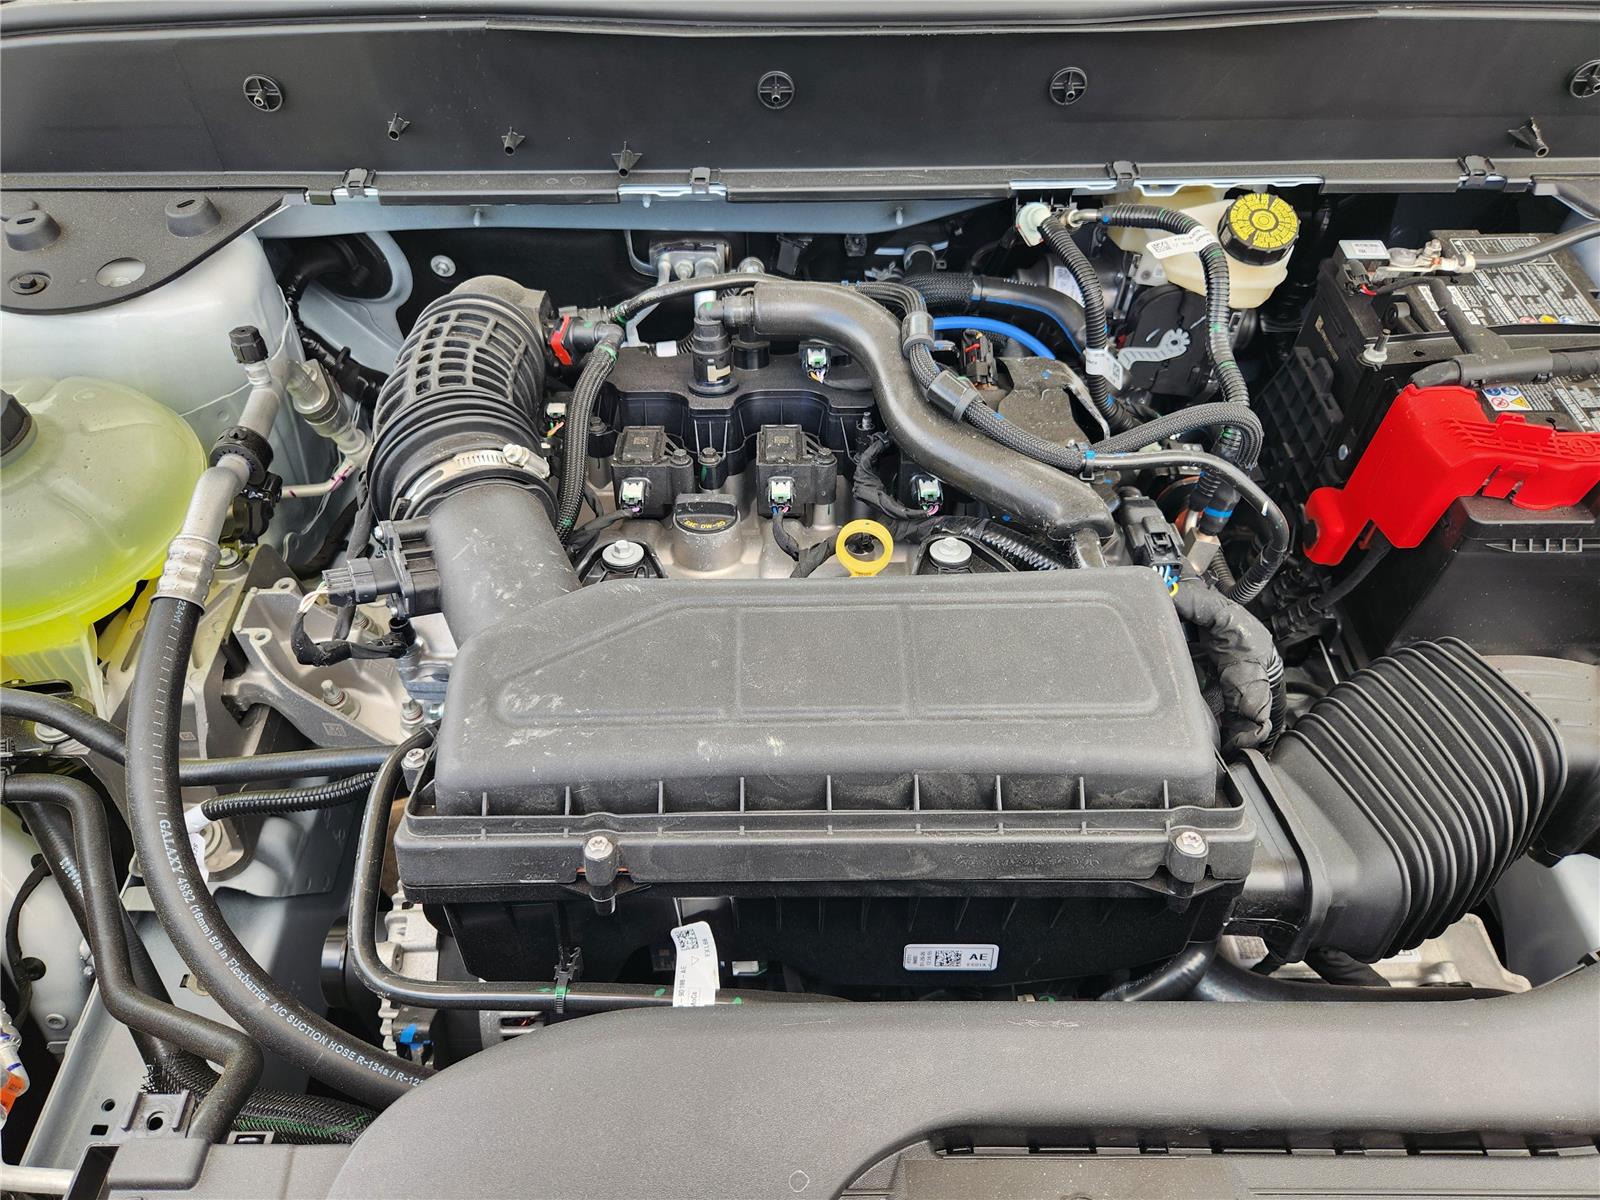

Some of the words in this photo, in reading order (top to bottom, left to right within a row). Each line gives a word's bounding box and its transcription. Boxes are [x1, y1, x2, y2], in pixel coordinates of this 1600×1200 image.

[159, 819, 185, 875] GALAXY
[176, 877, 196, 904] 4882
[189, 904, 214, 937] (16mm)
[208, 935, 223, 950] 5/8
[225, 957, 271, 1004] Flexbarrier
[269, 1002, 288, 1018] A/C
[286, 1014, 329, 1046] SUCTION
[328, 1040, 356, 1061] HOSE
[356, 1055, 390, 1076] R-134a
[969, 953, 989, 961] AE
